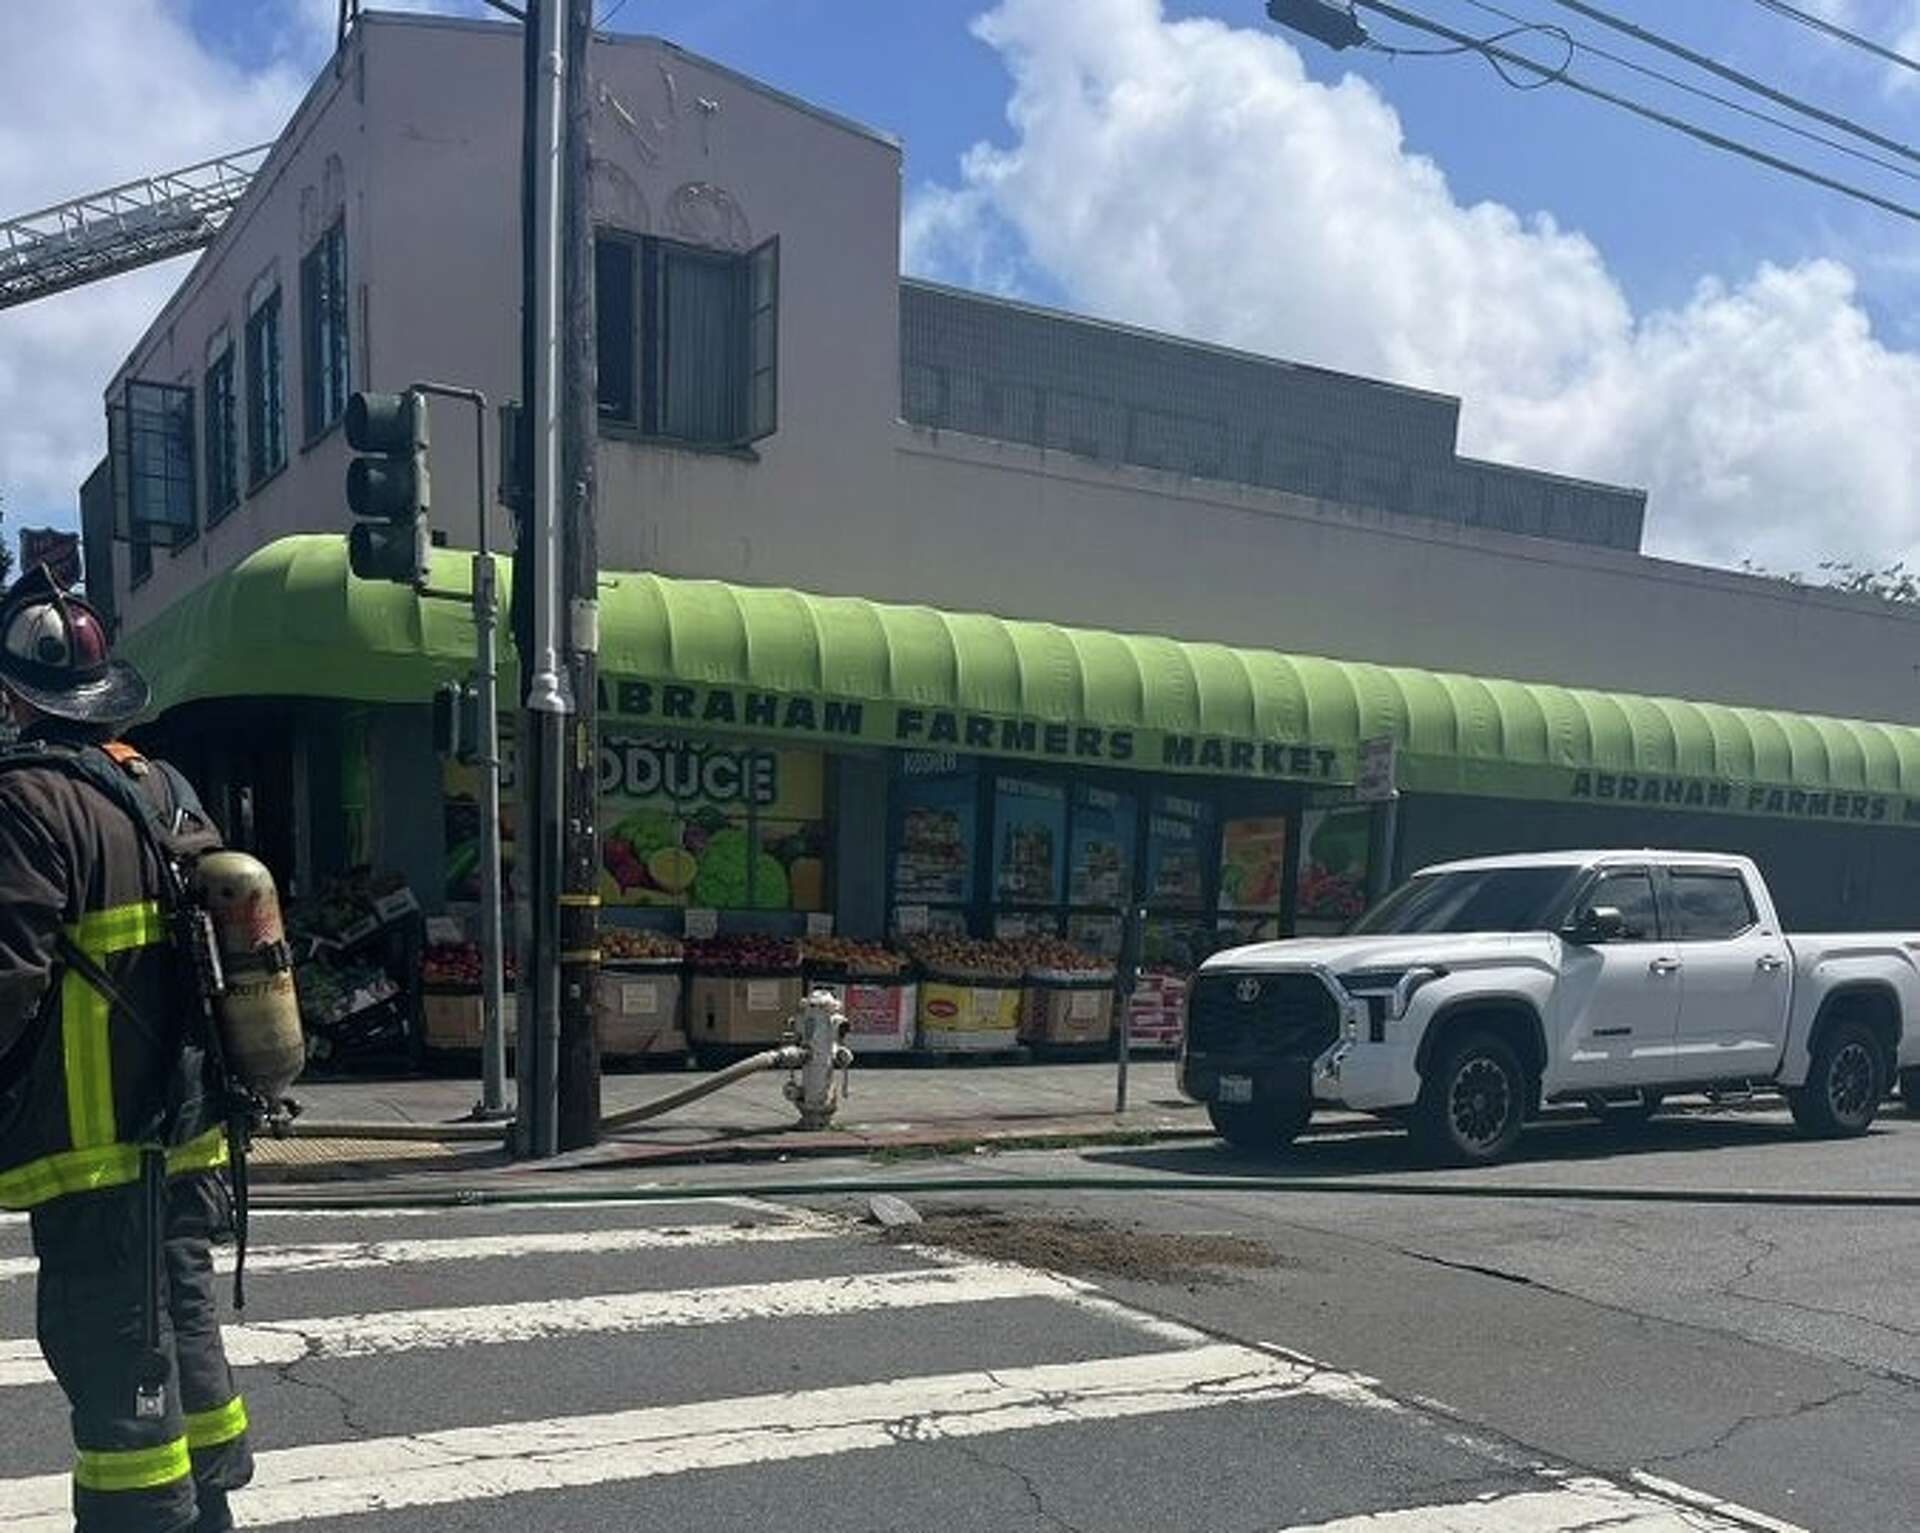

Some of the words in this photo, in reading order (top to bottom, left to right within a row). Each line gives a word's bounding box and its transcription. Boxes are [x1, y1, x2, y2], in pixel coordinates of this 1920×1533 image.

[597, 678, 863, 735] BRAHAM
[896, 707, 1134, 760] FARMERS
[1163, 737, 1337, 777] MARKET
[1571, 771, 1730, 808] ABRAHAM
[1748, 785, 1888, 821] FARMERS
